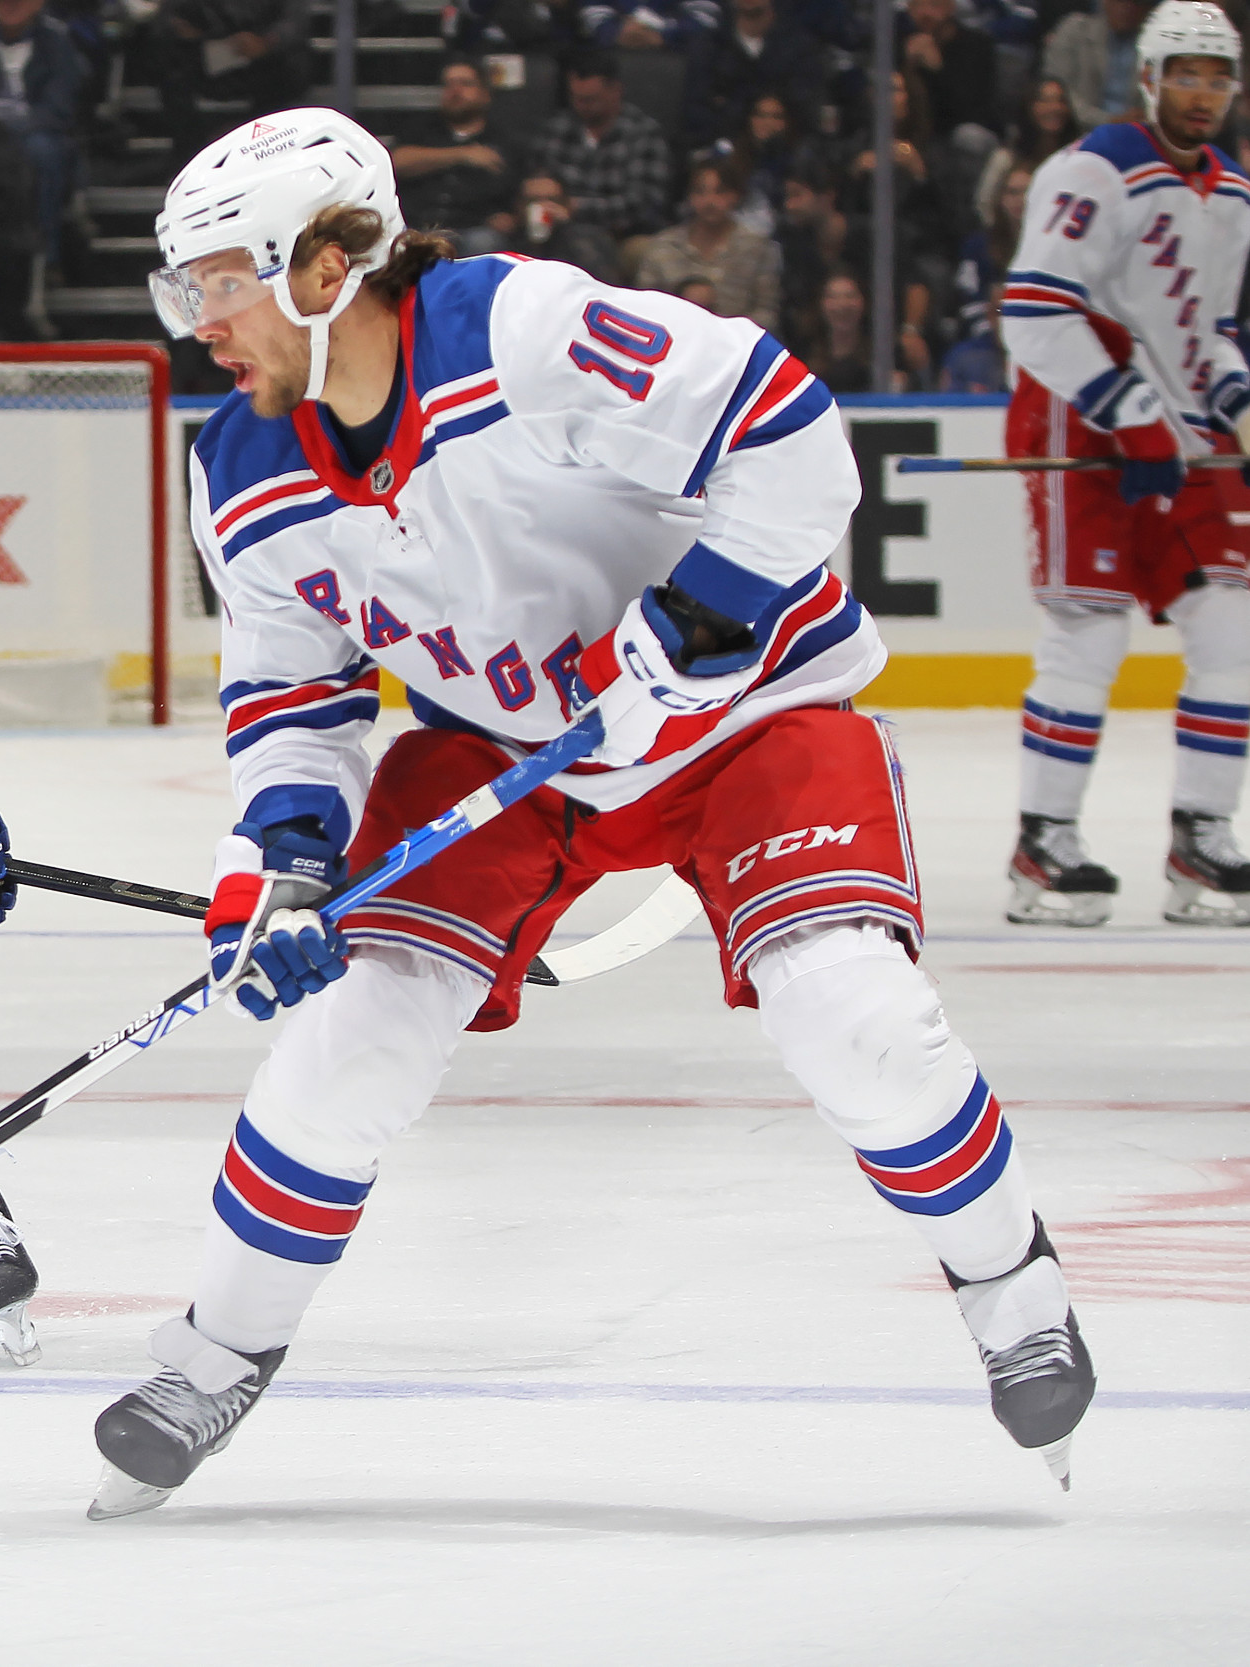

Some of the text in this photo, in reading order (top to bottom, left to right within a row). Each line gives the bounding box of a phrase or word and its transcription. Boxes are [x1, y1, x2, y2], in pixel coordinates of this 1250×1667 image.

[240, 127, 299, 155] Benjamin
[254, 139, 296, 161] Moore
[1043, 192, 1099, 241] 79
[567, 299, 674, 402] 10
[295, 568, 585, 723] RANGE
[291, 857, 327, 870] CCM
[726, 824, 860, 884] CCM
[89, 1001, 165, 1060] BAUER
